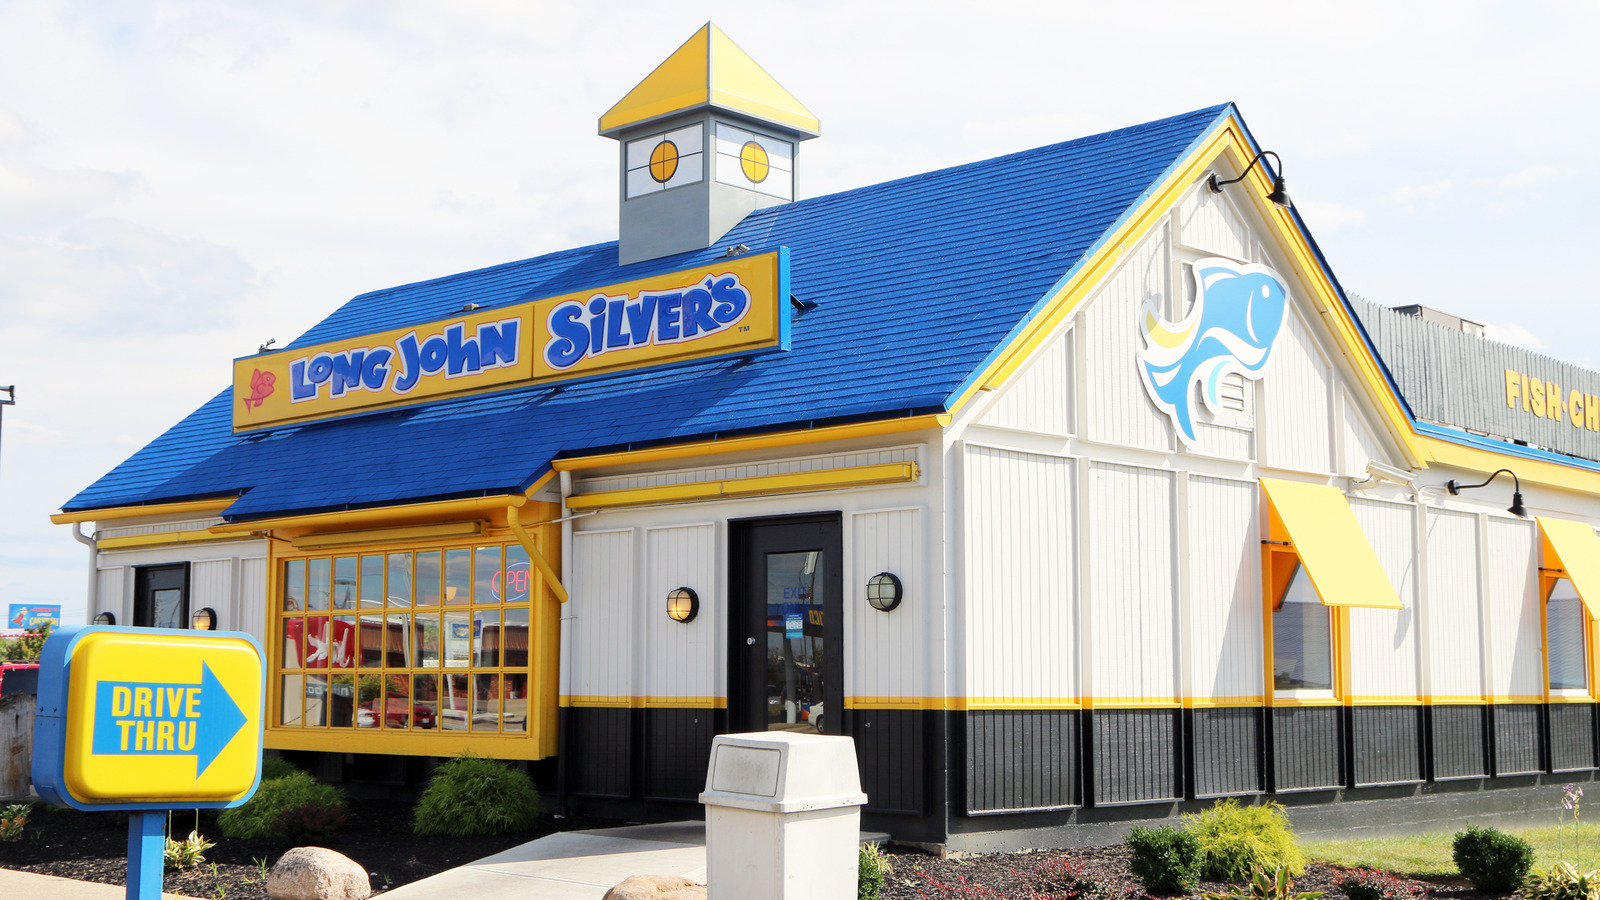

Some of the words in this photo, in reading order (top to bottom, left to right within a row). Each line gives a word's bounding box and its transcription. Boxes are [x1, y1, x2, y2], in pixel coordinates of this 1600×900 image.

[291, 348, 393, 401] LONG
[782, 601, 809, 614] ONLY
[783, 586, 807, 599] EXIT
[111, 686, 202, 717] DRIVE
[115, 720, 197, 751] THRU
